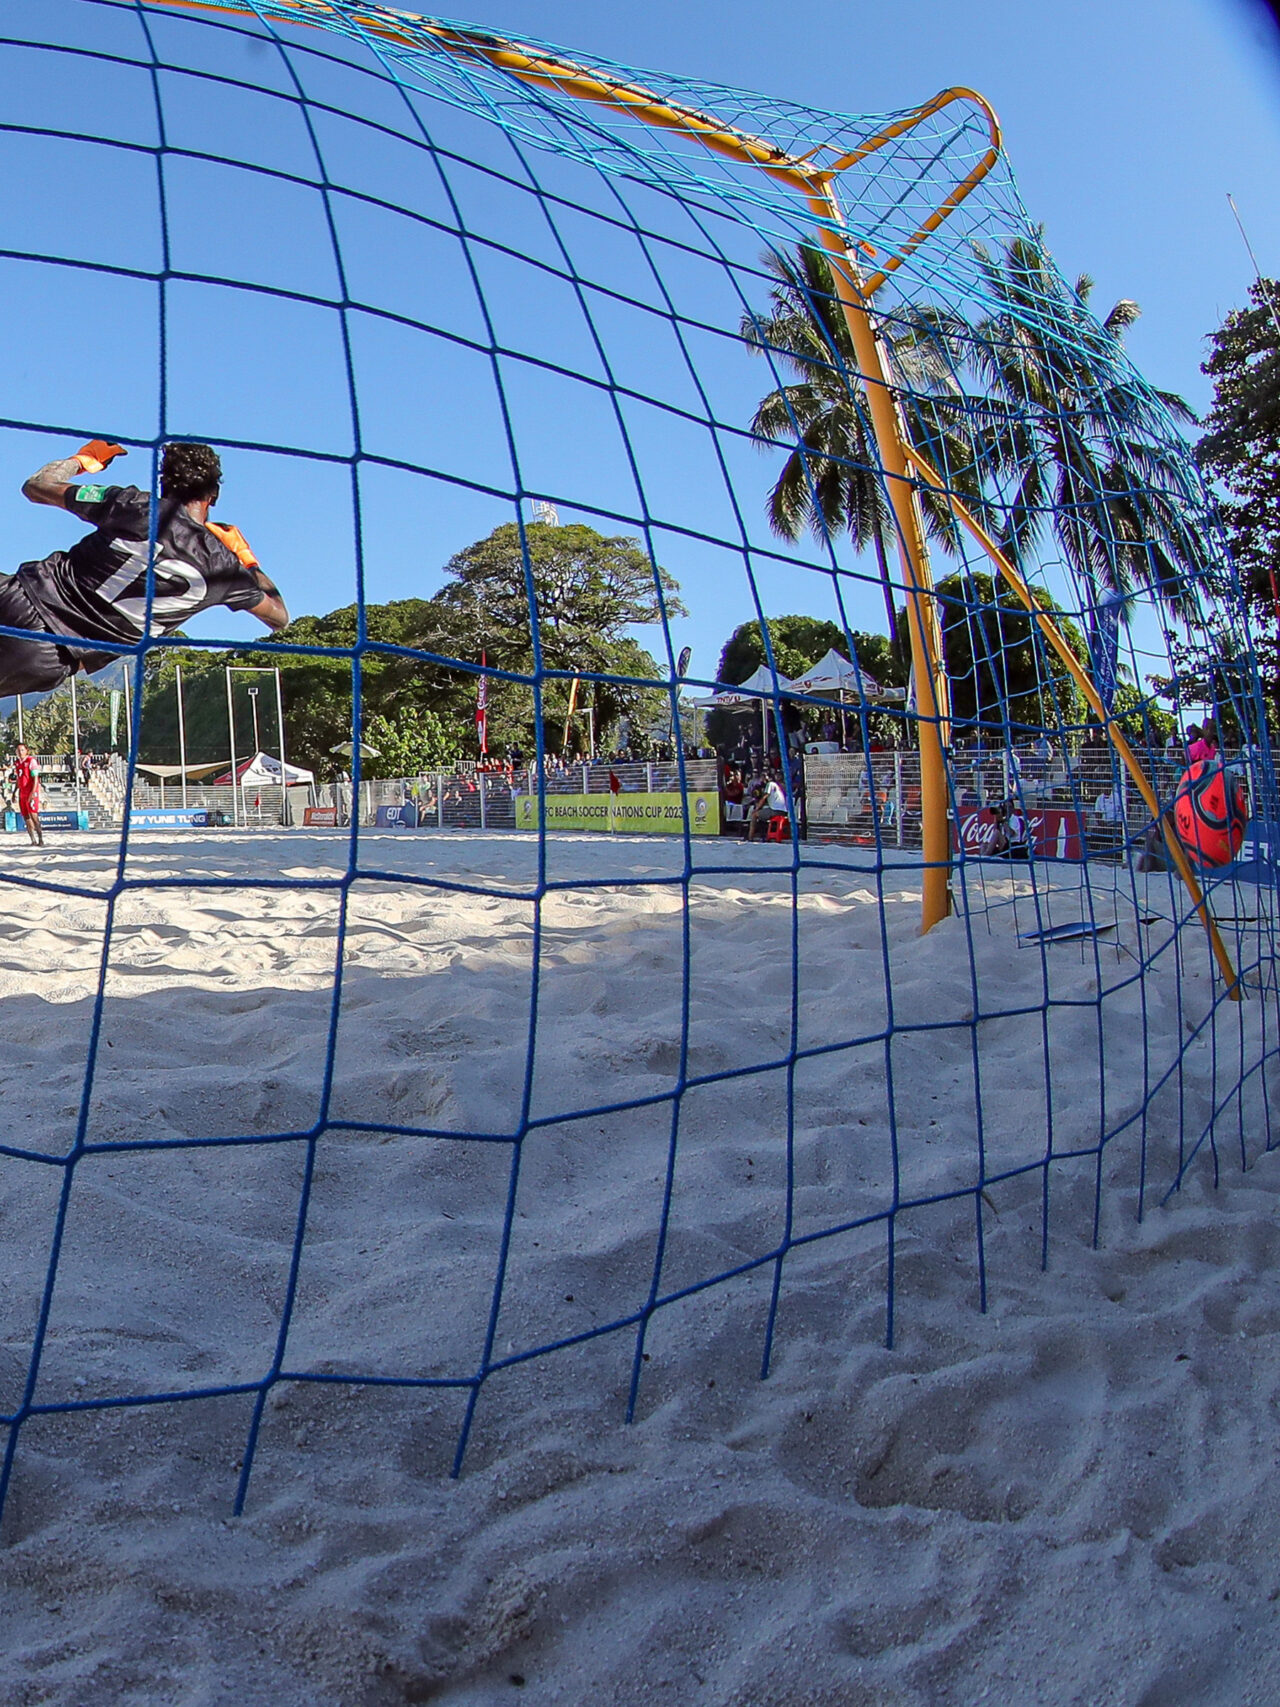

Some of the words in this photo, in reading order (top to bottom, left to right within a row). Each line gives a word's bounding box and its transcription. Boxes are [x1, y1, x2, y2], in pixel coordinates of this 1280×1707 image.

[96, 537, 208, 637] 12
[386, 807, 402, 820] EDT
[555, 807, 578, 818] BEACH
[579, 806, 609, 818] SOCCER
[611, 806, 644, 818] NATIONS
[645, 806, 662, 818] CUP
[664, 806, 683, 819] 2023
[147, 815, 176, 824] YUNE
[177, 815, 206, 824] TUNG
